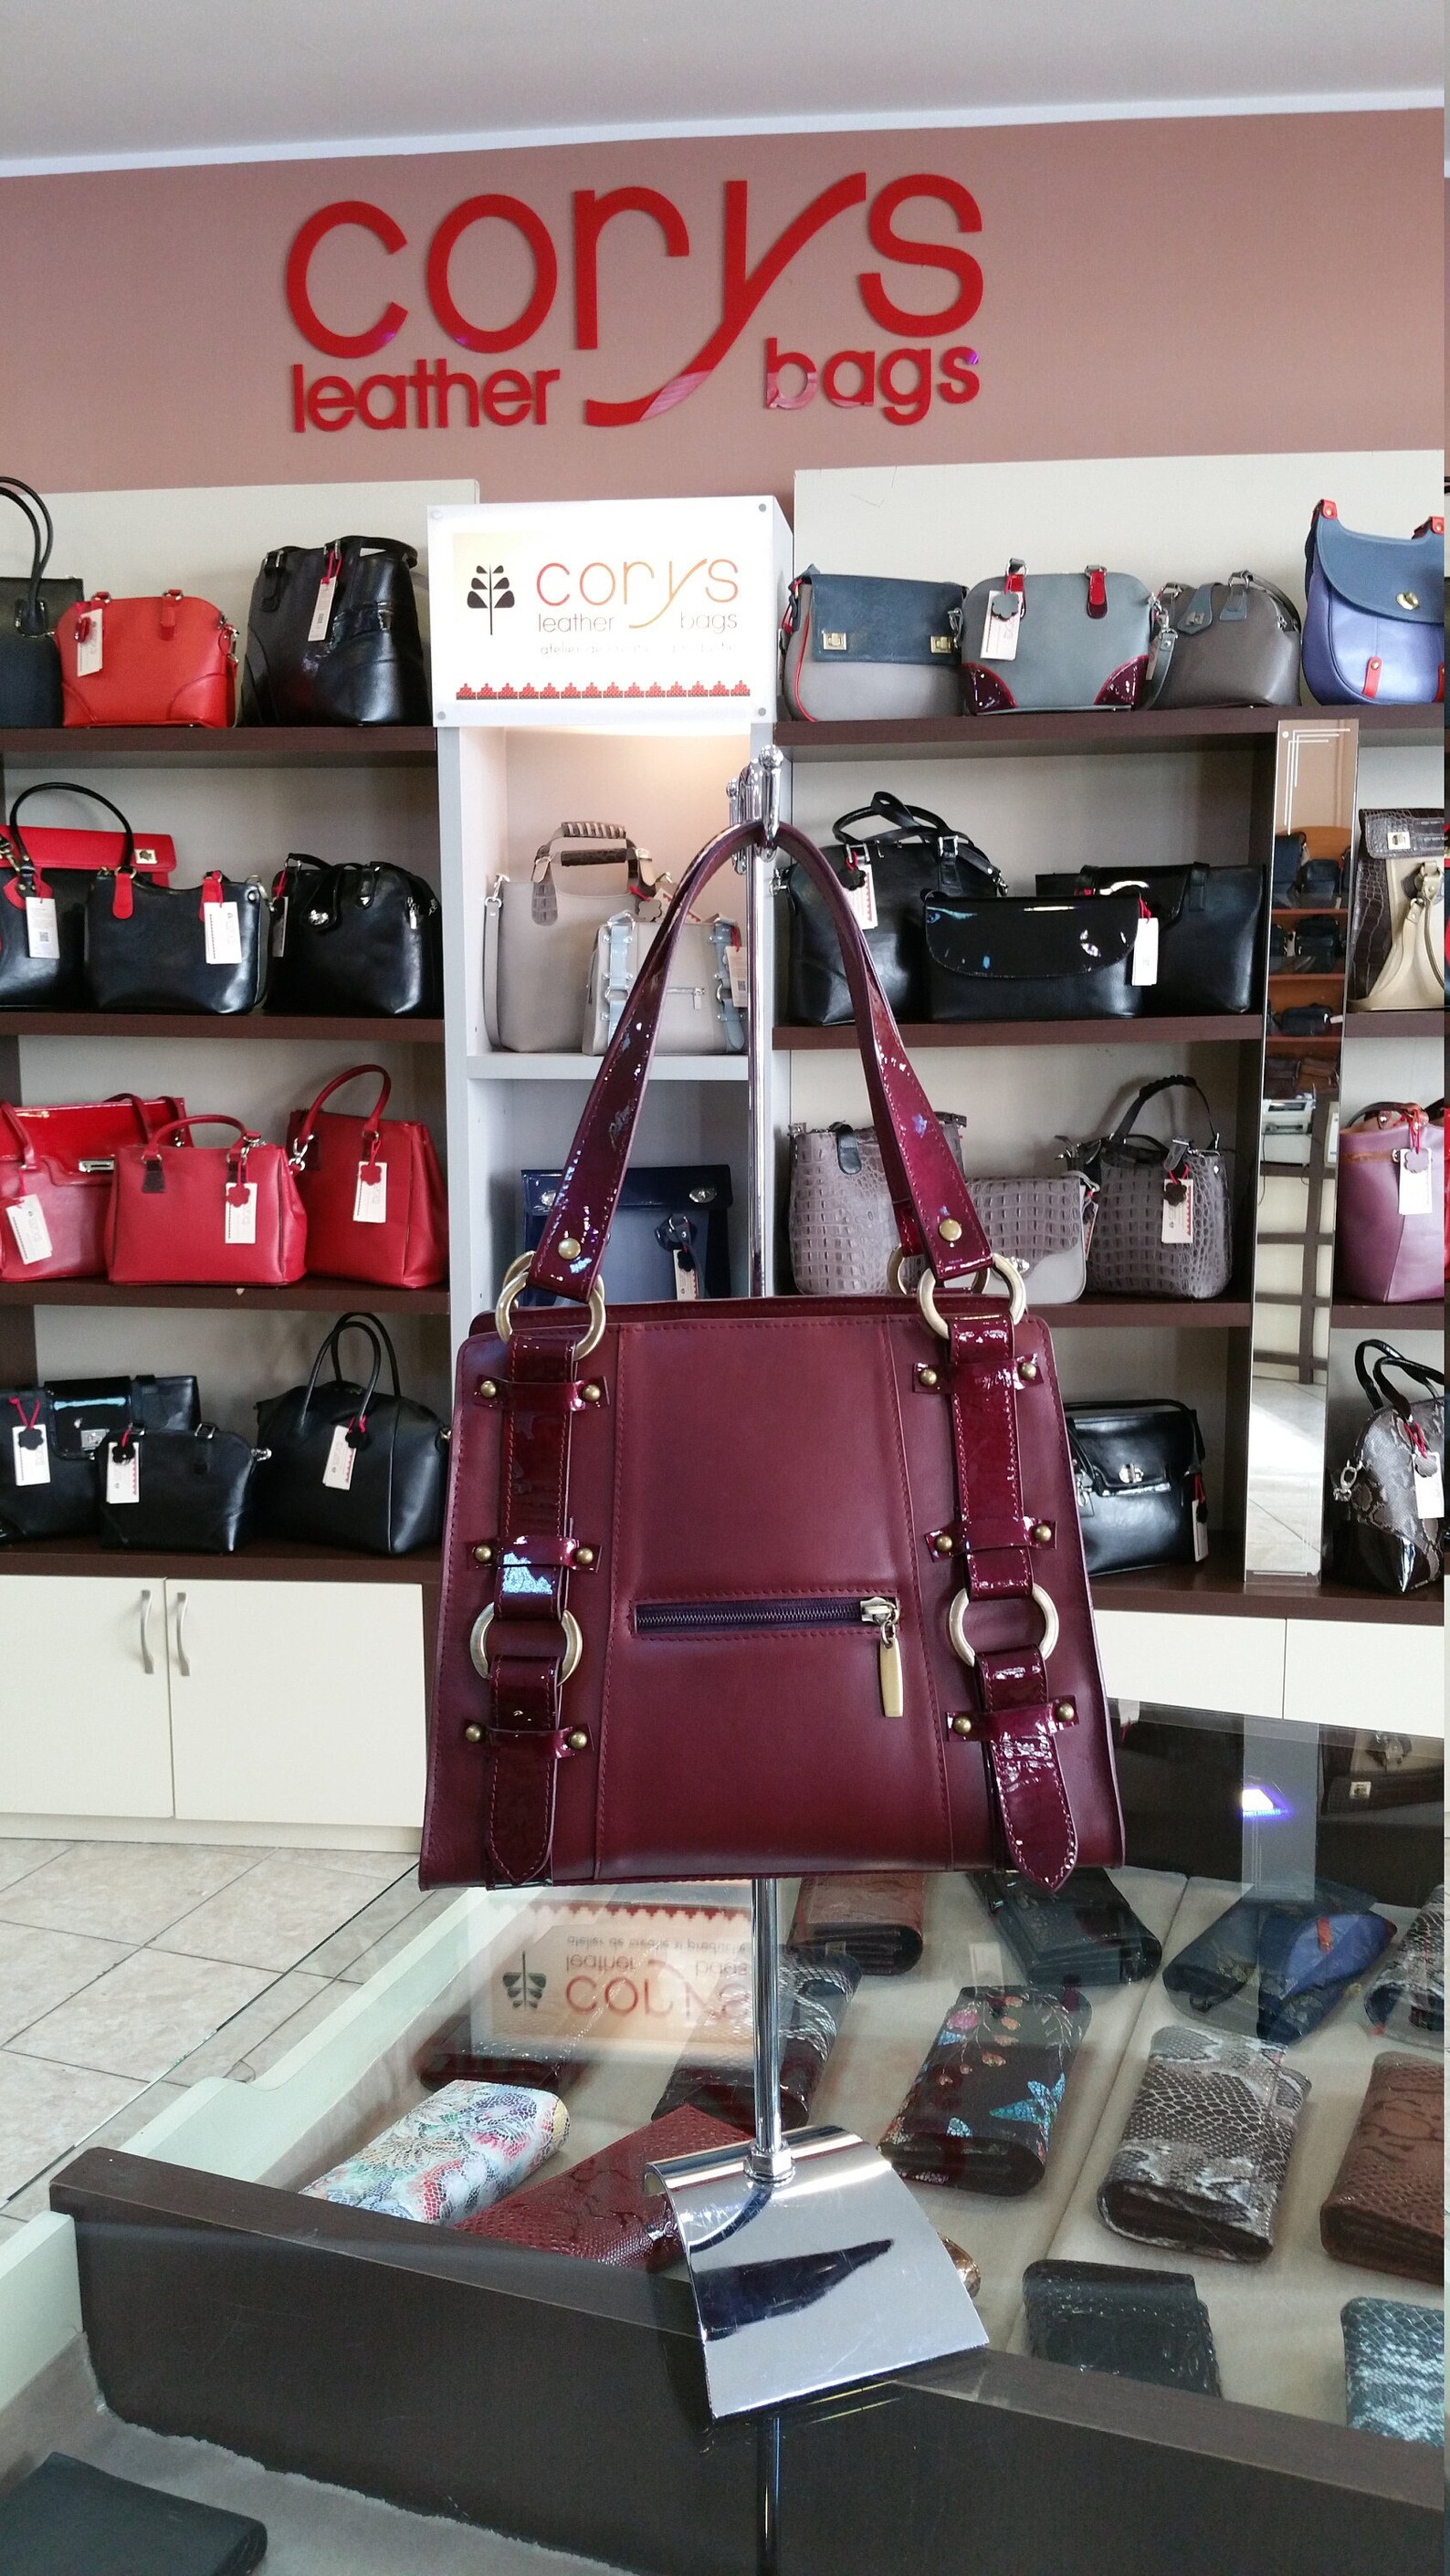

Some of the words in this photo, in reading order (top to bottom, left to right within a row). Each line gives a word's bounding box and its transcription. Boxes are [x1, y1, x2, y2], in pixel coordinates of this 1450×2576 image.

[285, 172, 983, 427] corys
[292, 359, 561, 433] leather
[763, 337, 981, 426] bags
[536, 559, 739, 629] corys
[537, 613, 615, 633] leather
[680, 611, 738, 634] bags
